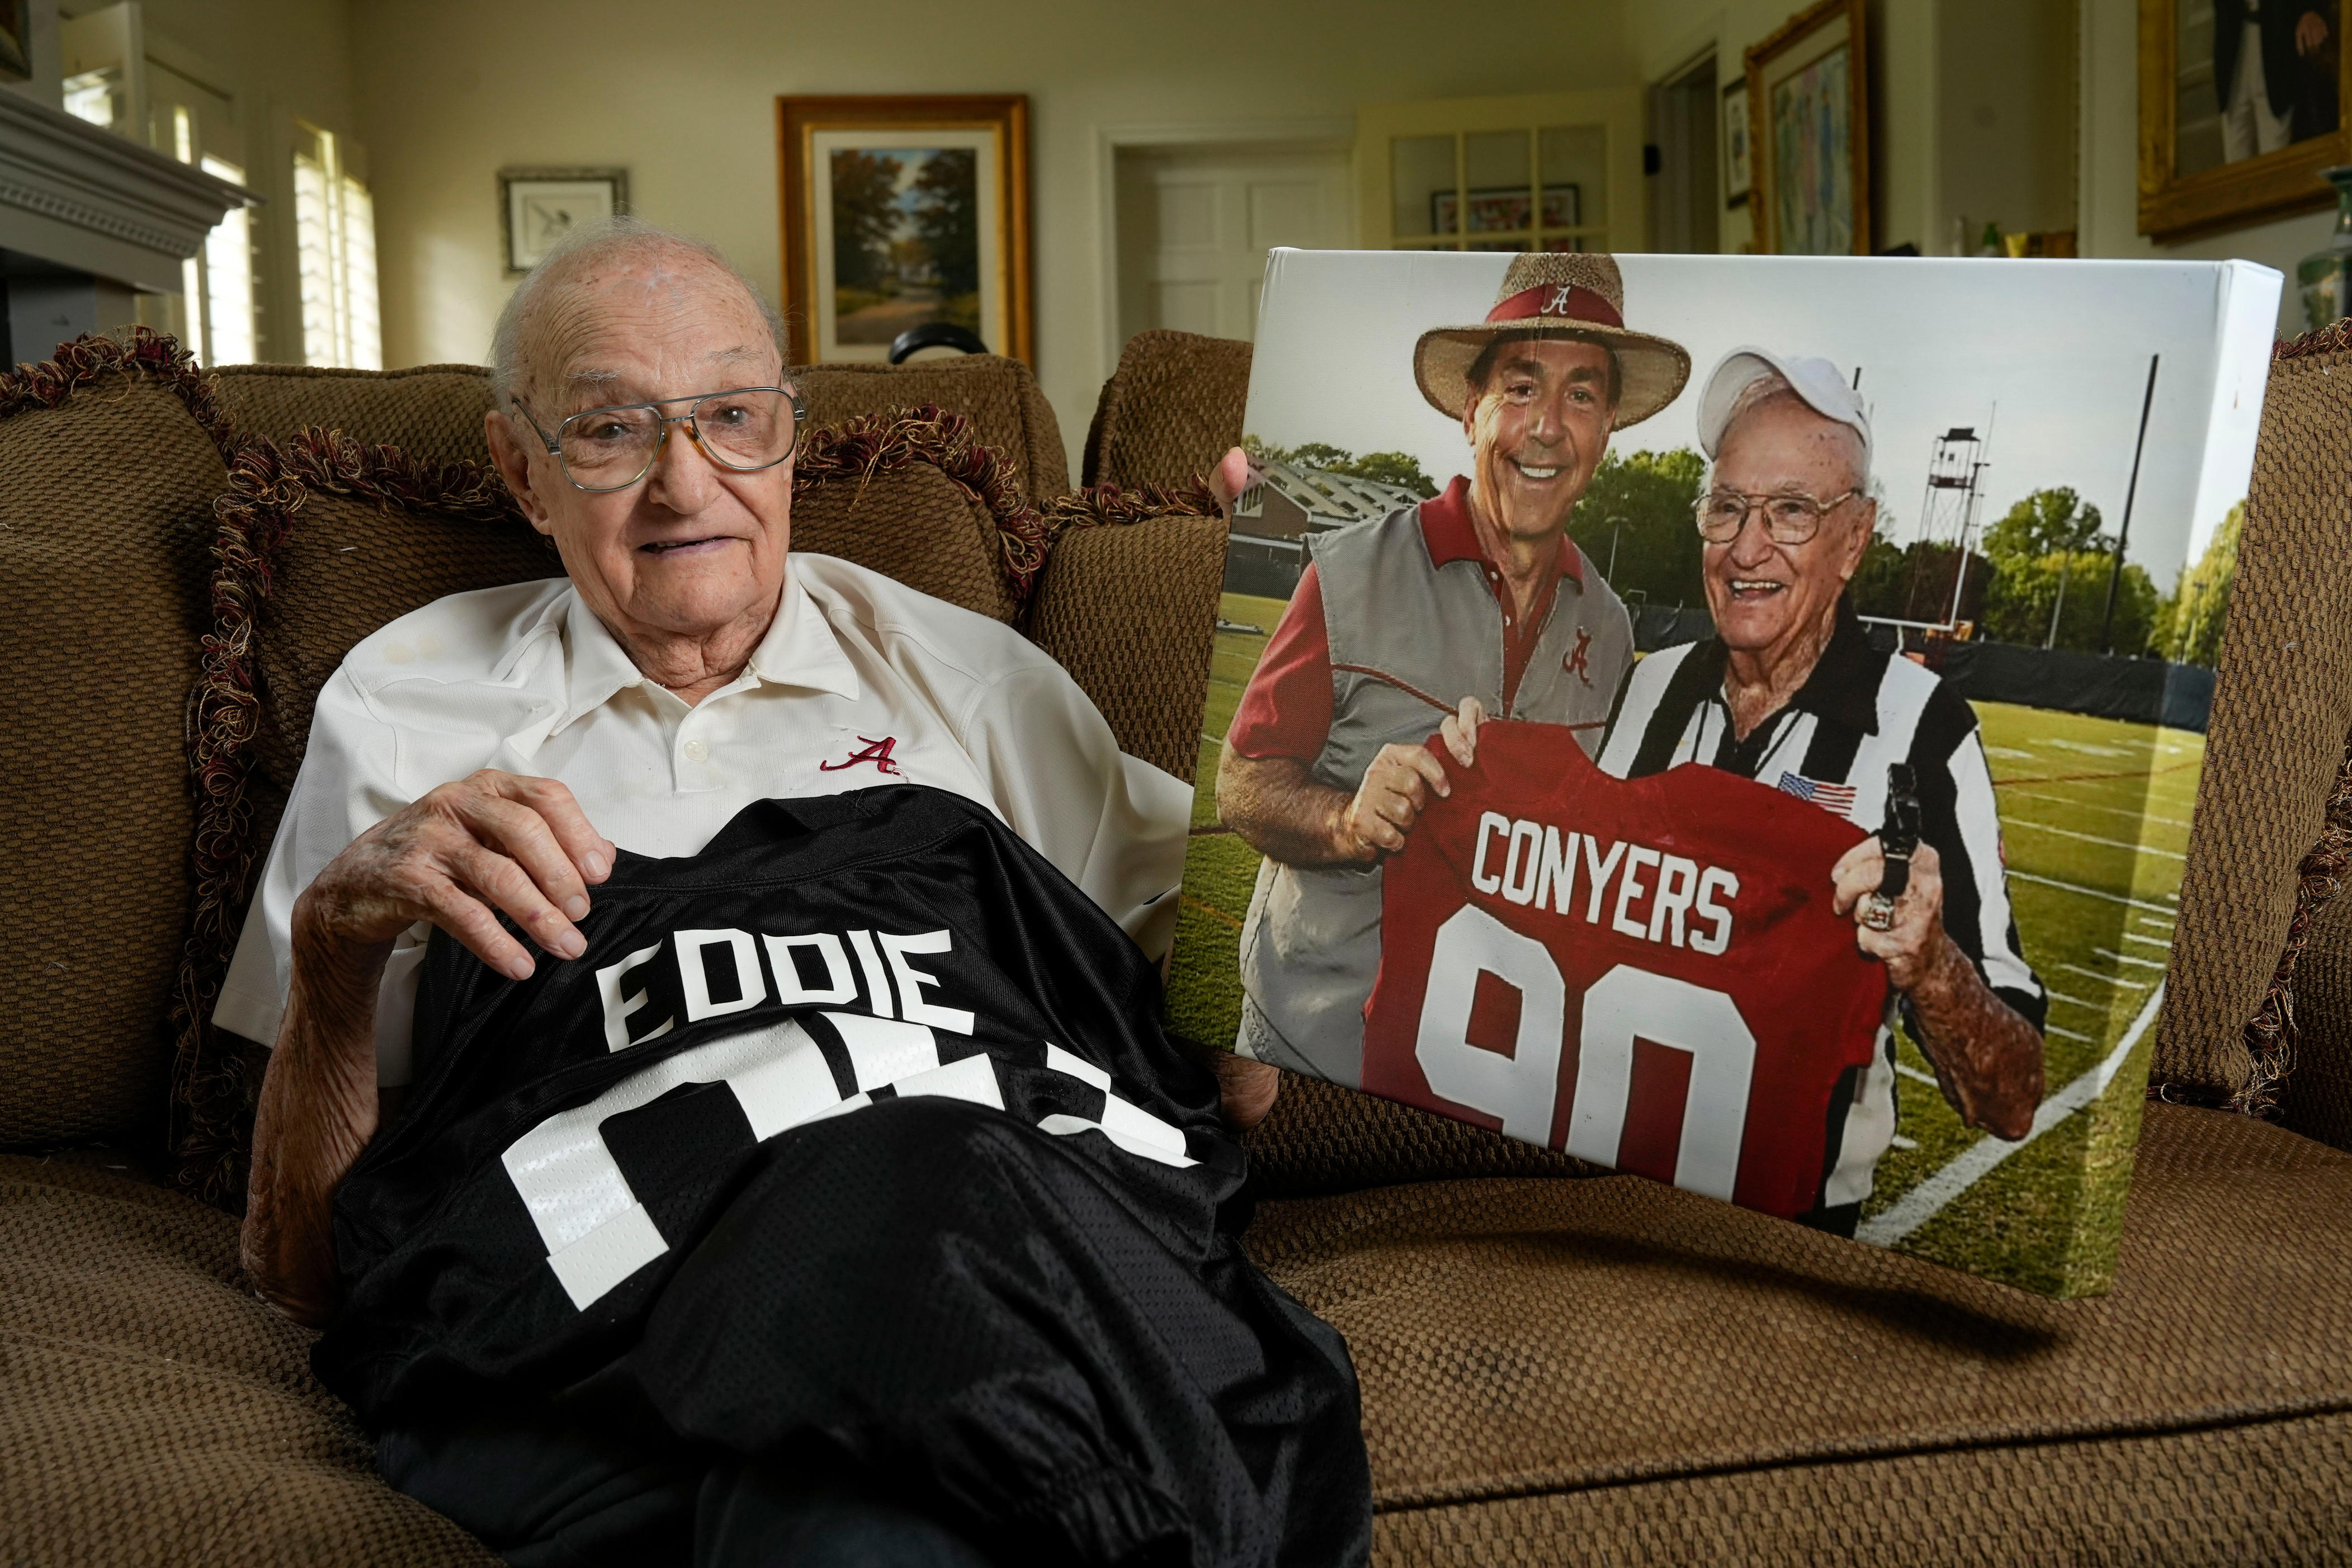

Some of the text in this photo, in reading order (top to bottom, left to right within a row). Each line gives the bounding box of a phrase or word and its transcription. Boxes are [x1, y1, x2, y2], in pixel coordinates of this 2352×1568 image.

[1540, 286, 1571, 315] A
[819, 736, 901, 776] A
[1472, 811, 1740, 956] CONYERS
[595, 928, 975, 1054] EDDIE
[1415, 903, 1757, 1204] 90
